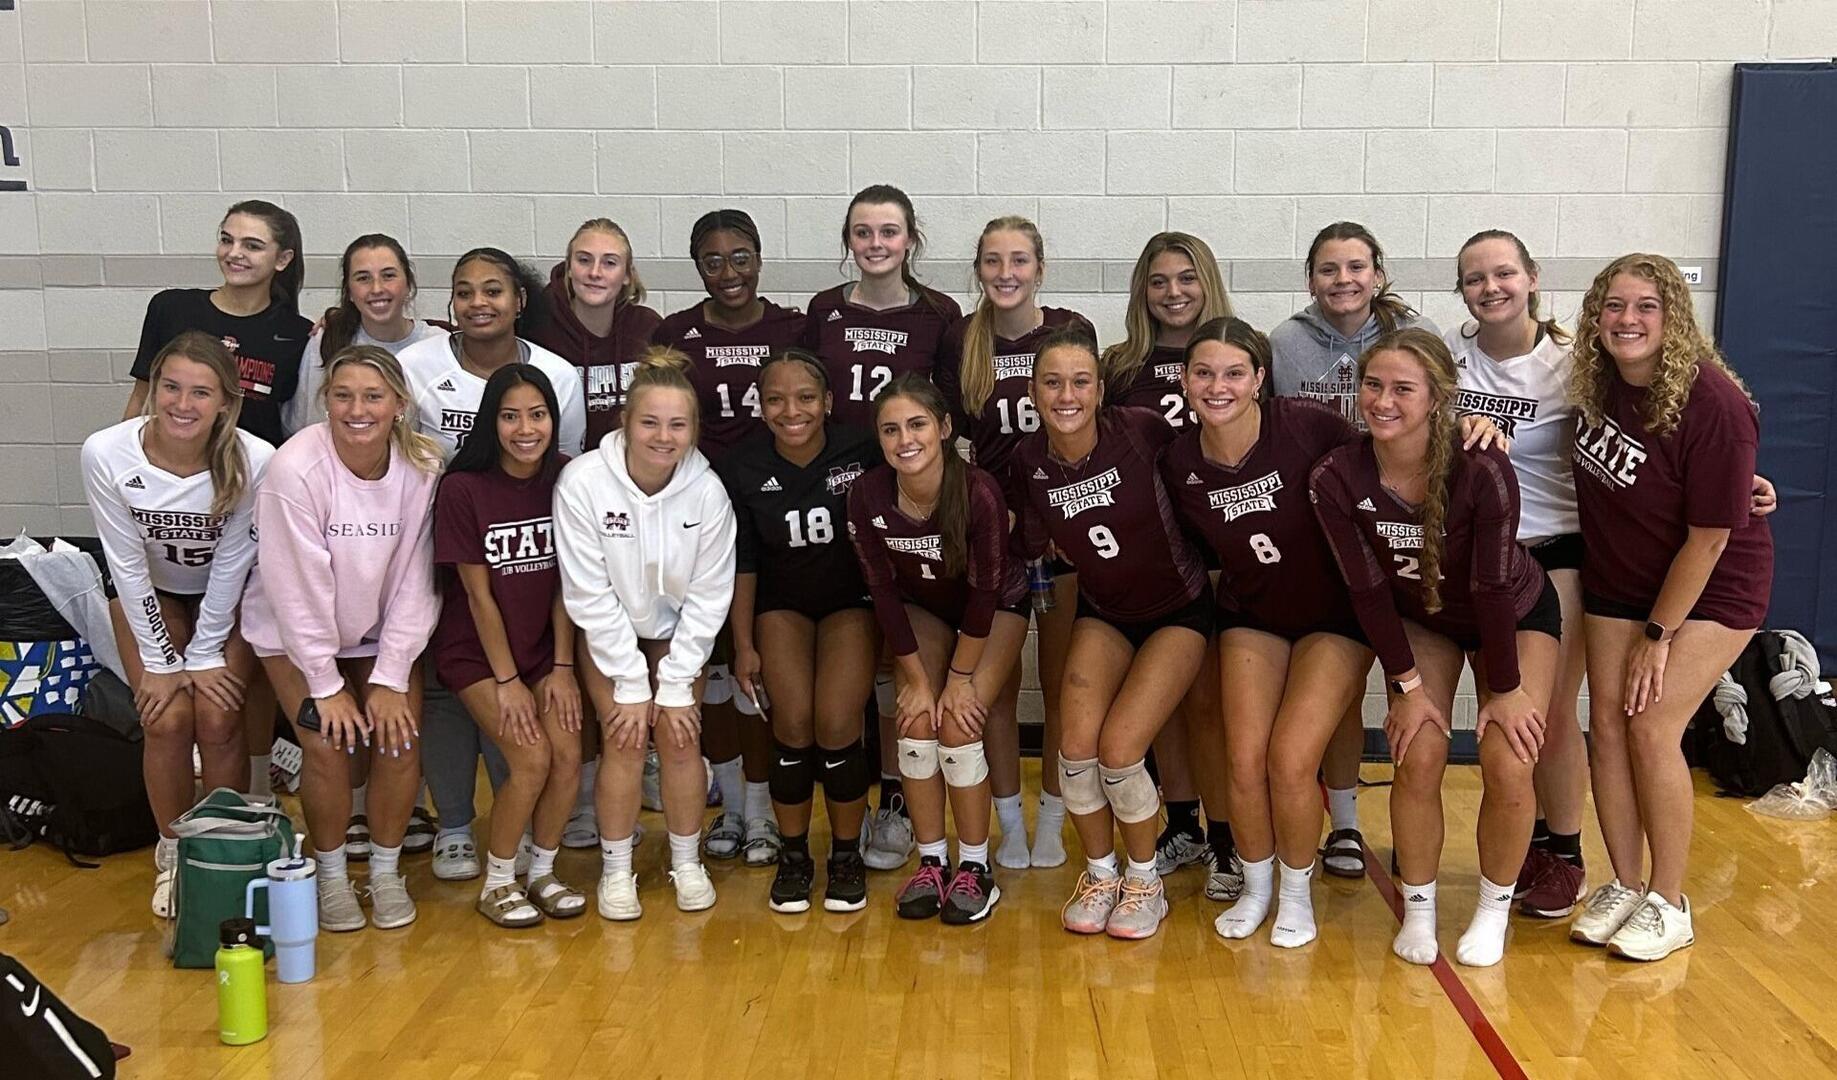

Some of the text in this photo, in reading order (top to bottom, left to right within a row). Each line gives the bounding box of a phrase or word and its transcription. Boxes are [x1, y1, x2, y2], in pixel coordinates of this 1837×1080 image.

[846, 330, 908, 344] MISSISSIPPI
[861, 341, 889, 352] STATE
[707, 348, 769, 356] MISSISSIPPI
[993, 355, 1034, 367] ISSISSI
[850, 364, 892, 401] 12
[1003, 368, 1032, 377] STATE
[717, 382, 761, 417] 14
[1454, 393, 1538, 418] ISSISSIPPI
[441, 412, 473, 429] MIS
[997, 396, 1040, 434] 16
[1160, 394, 1198, 427] 2
[1048, 470, 1120, 504] MISSISSIPPI
[1209, 473, 1282, 506] MISSISSIPPI
[1071, 494, 1104, 513] STATE
[1232, 500, 1266, 517] STATE
[159, 529, 211, 540] STATE
[327, 522, 401, 537] SEASID
[785, 507, 834, 547] 18
[1377, 524, 1425, 537] MISSISS
[886, 538, 940, 549] MISSISSIP
[1088, 525, 1119, 559] 9
[1249, 533, 1281, 564] 8
[163, 544, 214, 567] 15
[142, 595, 177, 666] BULLDOGS
